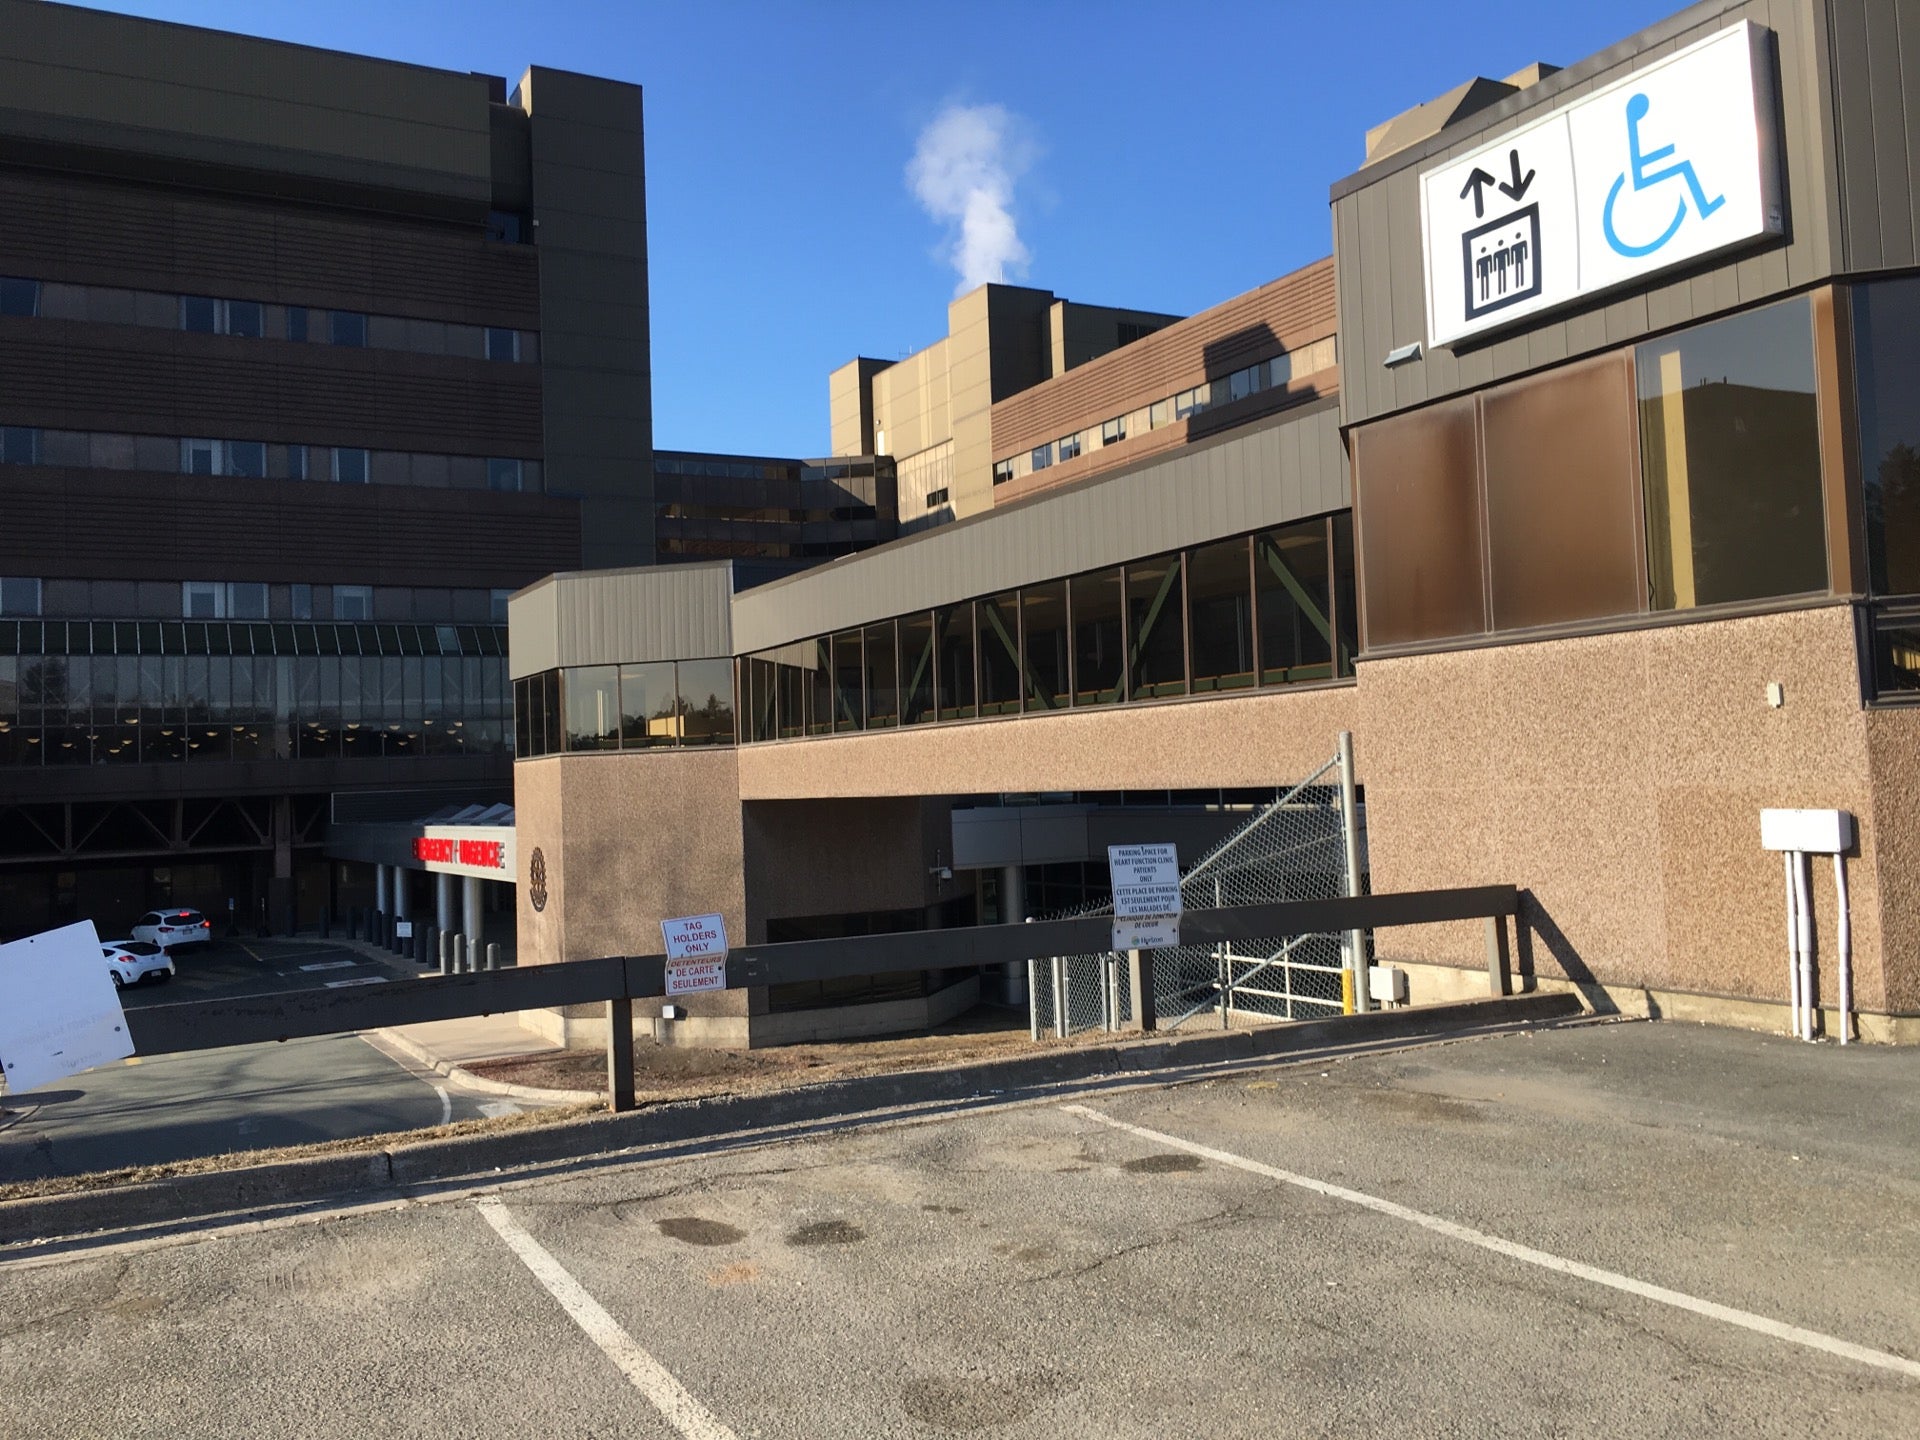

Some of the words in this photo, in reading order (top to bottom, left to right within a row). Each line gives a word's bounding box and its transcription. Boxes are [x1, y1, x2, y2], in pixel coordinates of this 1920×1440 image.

[1118, 849, 1140, 857] PARKING
[1141, 848, 1156, 856] SPACE
[1157, 847, 1168, 855] FOR
[1114, 858, 1131, 866] HEART
[1131, 857, 1157, 865] FUNCTION
[1157, 856, 1174, 864] CLINIC
[1133, 866, 1157, 874] PATIENTS
[1116, 887, 1131, 895] CETTE
[1132, 887, 1148, 895] PLACE
[1148, 886, 1156, 894] DE
[1156, 885, 1178, 893] PARKING
[1131, 895, 1160, 904] SEULEMENT
[1160, 894, 1175, 902] POUR
[1138, 904, 1163, 912] MALADES
[1162, 903, 1170, 911] DE
[684, 921, 703, 931] TAG
[673, 930, 717, 944] HOLDERS
[685, 942, 709, 953] ONLY
[676, 968, 687, 977] DE
[688, 965, 715, 976] CARTE
[672, 976, 719, 990] SEULEMENT
